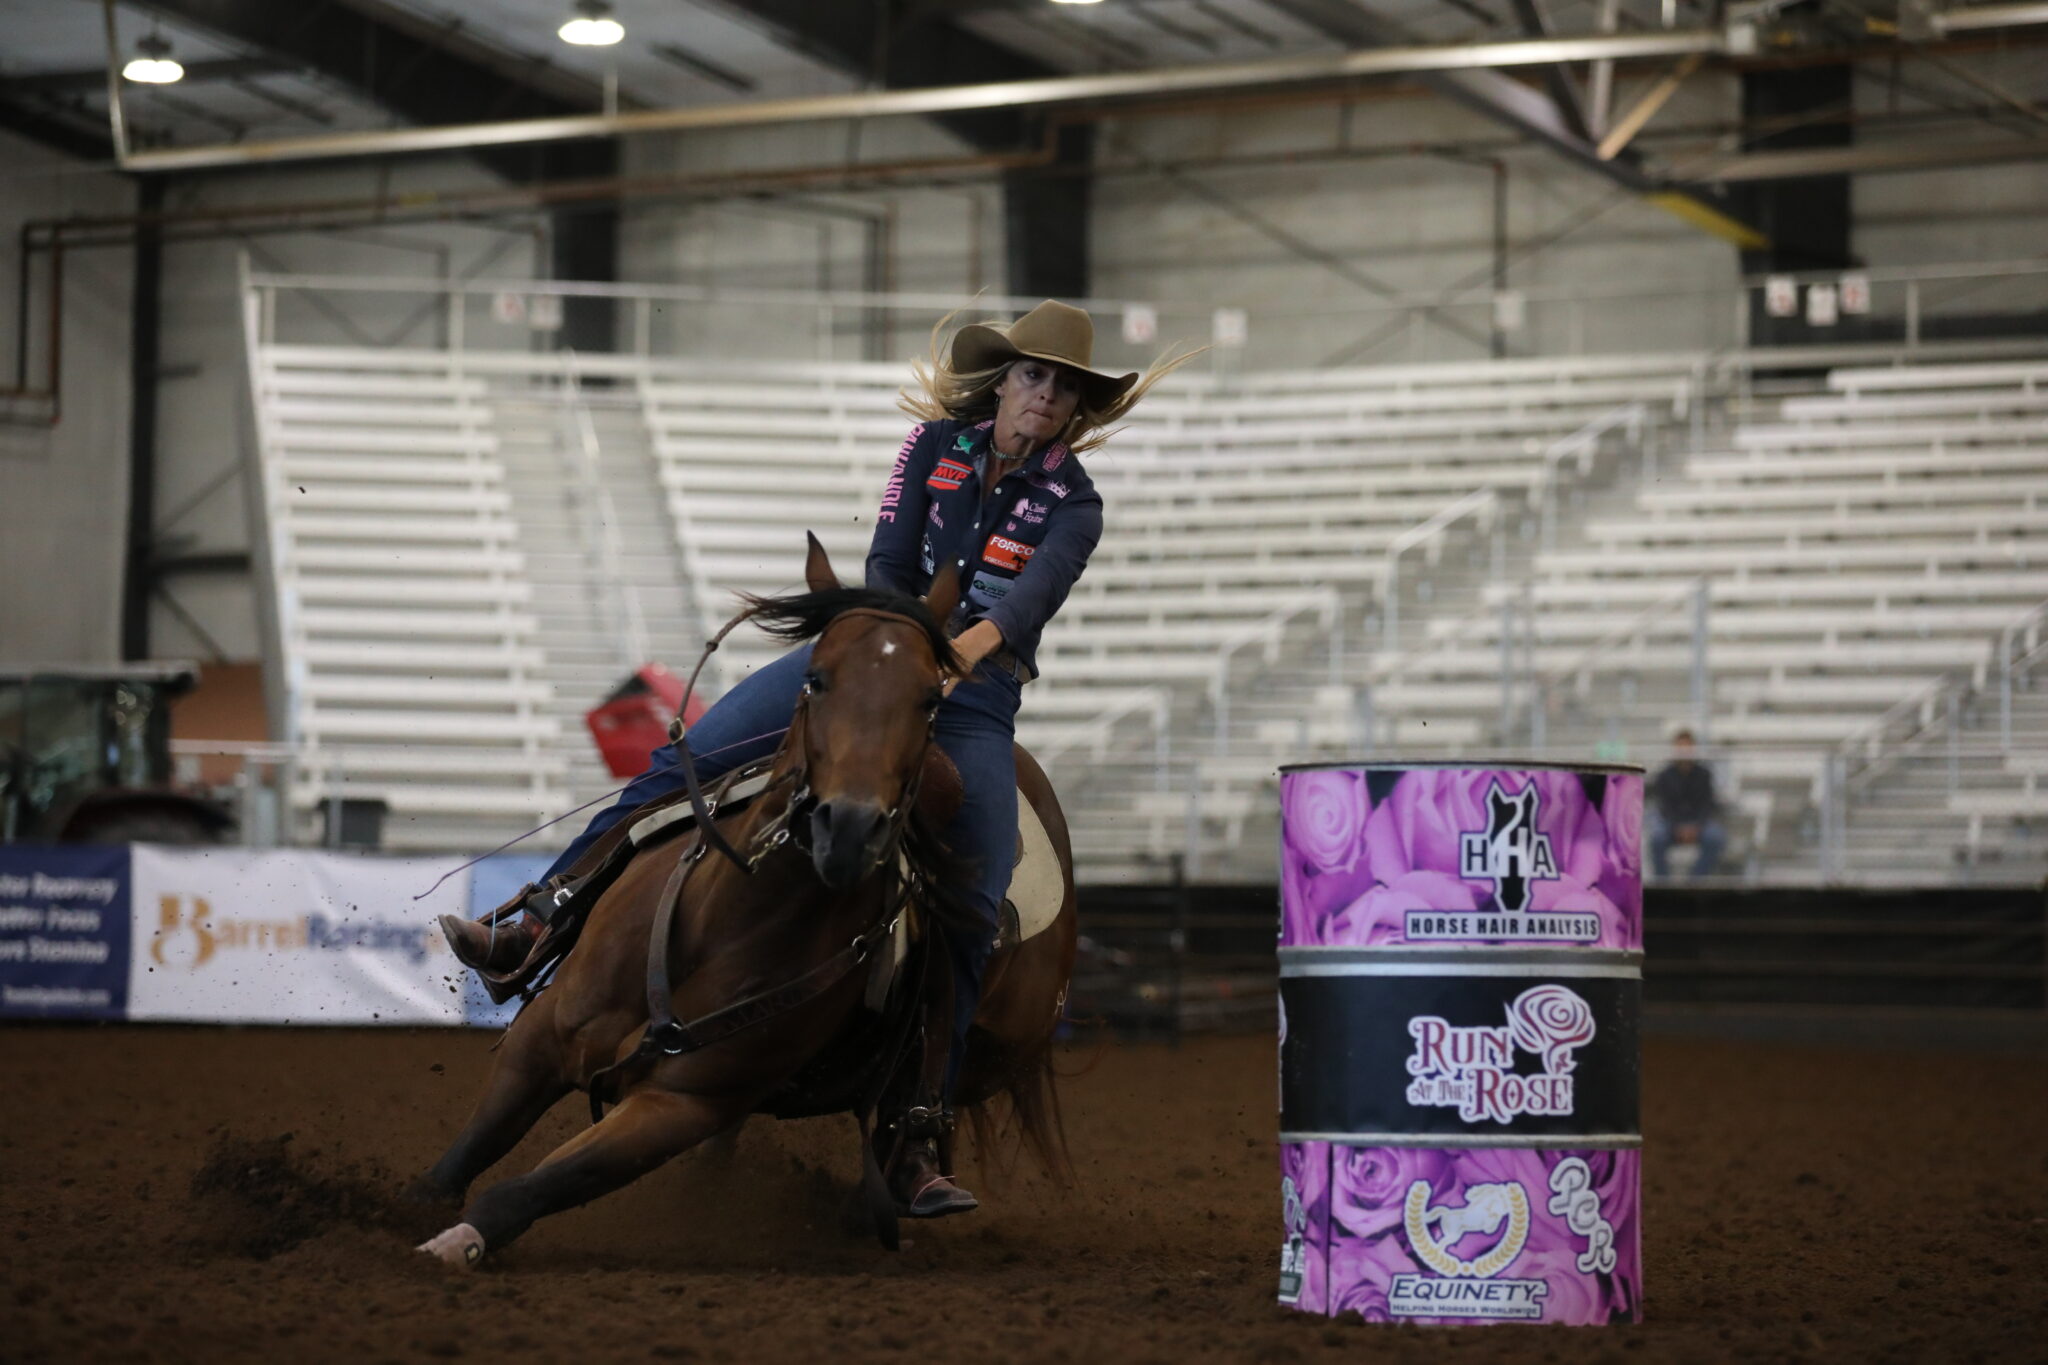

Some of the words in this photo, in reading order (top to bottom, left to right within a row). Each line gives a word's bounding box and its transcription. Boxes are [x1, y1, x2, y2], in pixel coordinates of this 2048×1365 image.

[879, 423, 926, 524] PANHANDLE
[932, 466, 969, 481] MVP
[990, 536, 1035, 556] FORCO
[1411, 918, 1468, 934] HORSE
[1477, 918, 1519, 935] HAIR
[1526, 918, 1597, 936] ANALYSIS
[1411, 1020, 1509, 1073] RUN
[1465, 1068, 1570, 1120] ROSE
[1393, 1278, 1538, 1301] EQUINETY
[1393, 1303, 1434, 1313] HELPING
[1438, 1304, 1476, 1313] HORSES
[1480, 1305, 1537, 1315] WORLDWIDE
